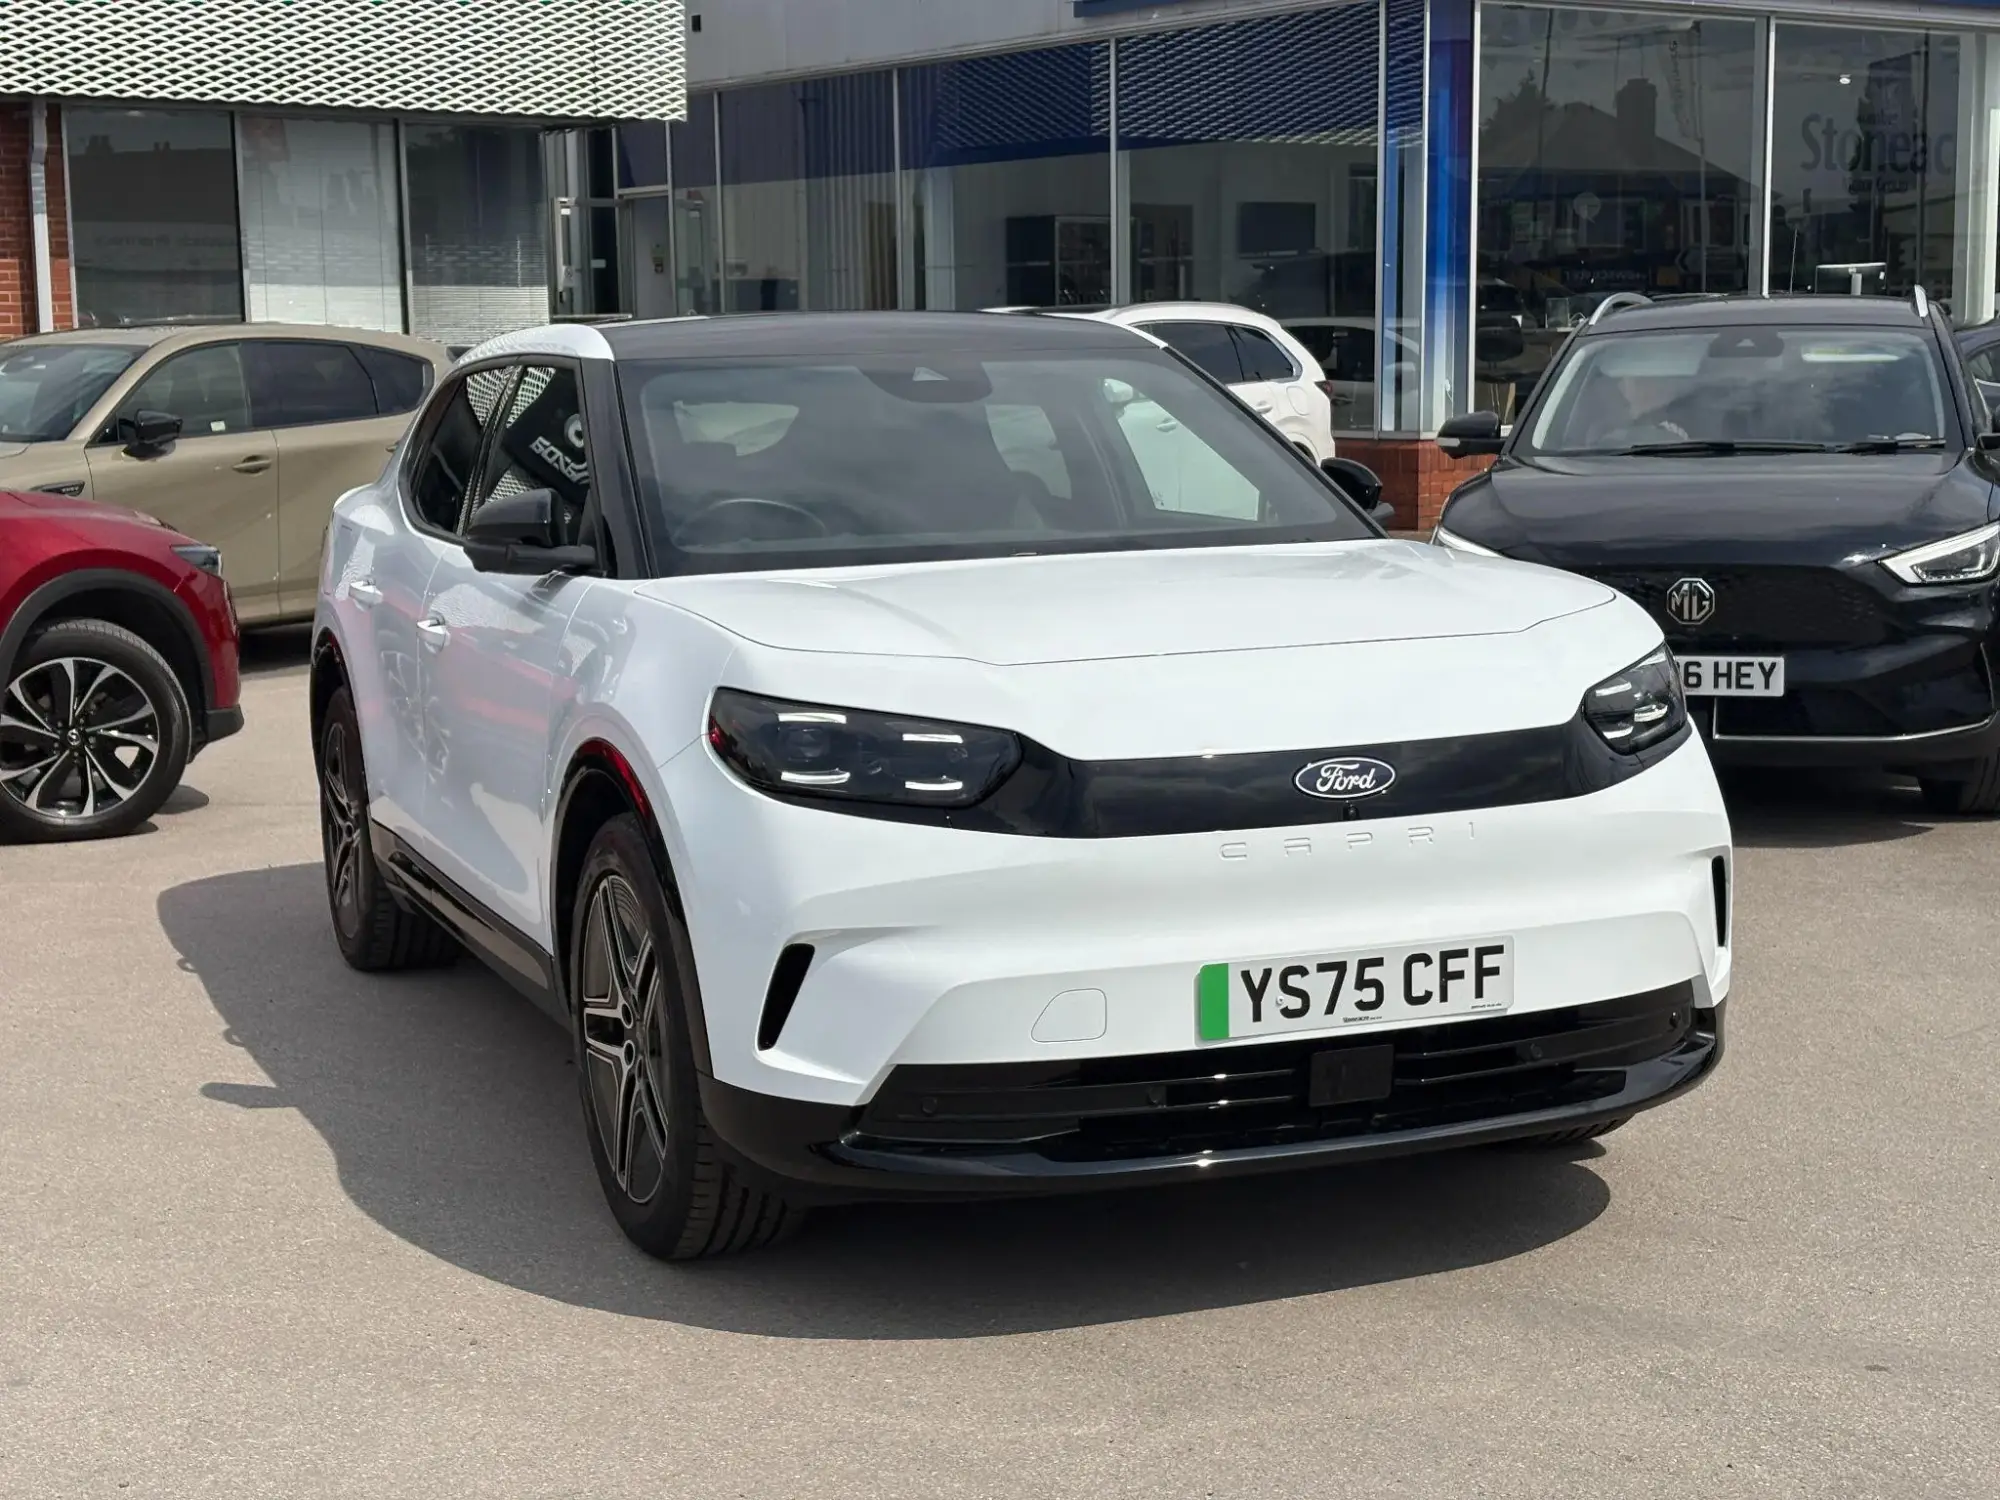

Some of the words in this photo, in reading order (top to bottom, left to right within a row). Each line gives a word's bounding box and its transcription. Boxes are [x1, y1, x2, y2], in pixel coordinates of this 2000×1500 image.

[1671, 582, 1710, 620] MG
[1677, 661, 1702, 688] 6
[1713, 661, 1777, 690] HEY
[1316, 763, 1376, 792] Ford
[1219, 821, 1475, 861] CAPRI
[1240, 957, 1385, 1023] YS75
[1403, 944, 1505, 1006] CFF
